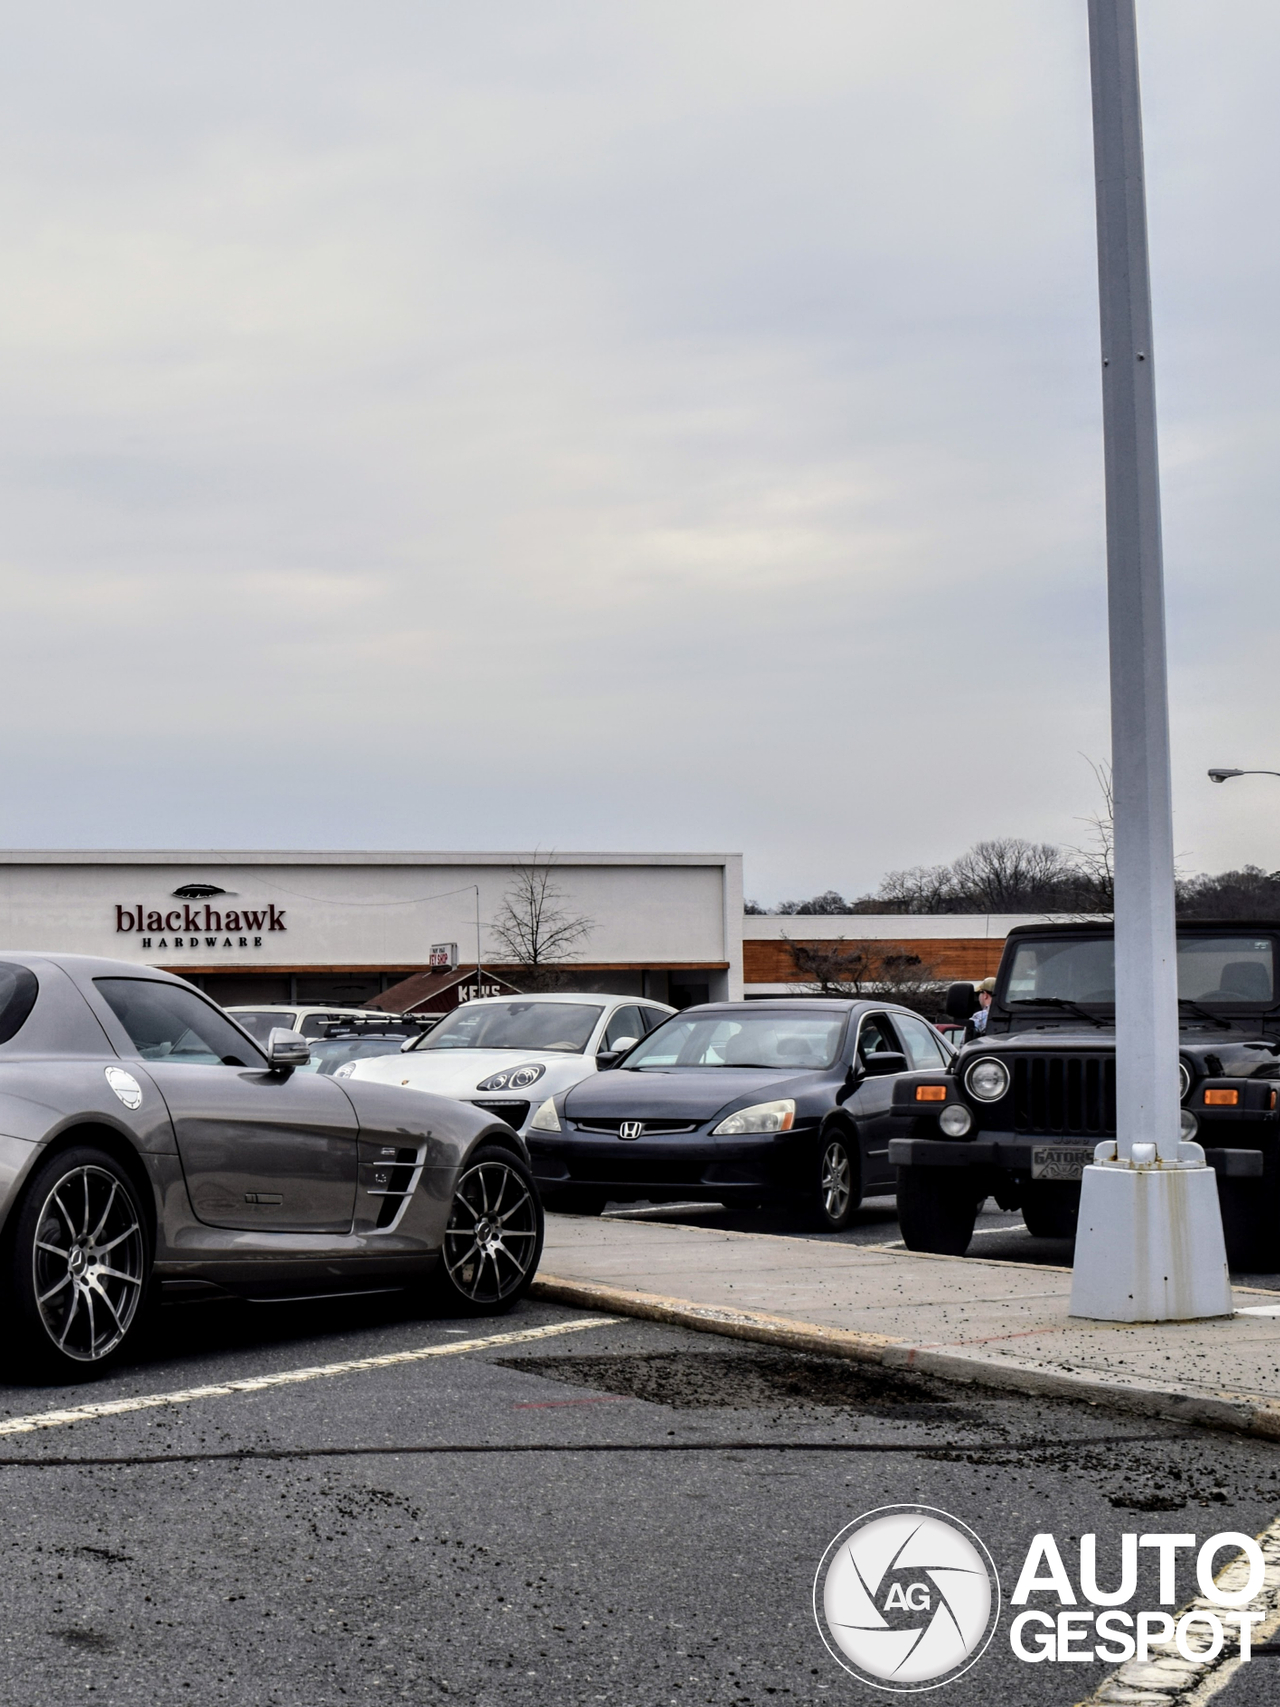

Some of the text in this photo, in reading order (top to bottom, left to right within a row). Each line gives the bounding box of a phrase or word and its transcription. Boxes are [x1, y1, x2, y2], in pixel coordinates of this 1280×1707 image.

[115, 904, 287, 932] blackhawk
[142, 937, 262, 948] HARDWARE
[458, 985, 500, 1002] KEYS
[1034, 1152, 1095, 1165] GATORS
